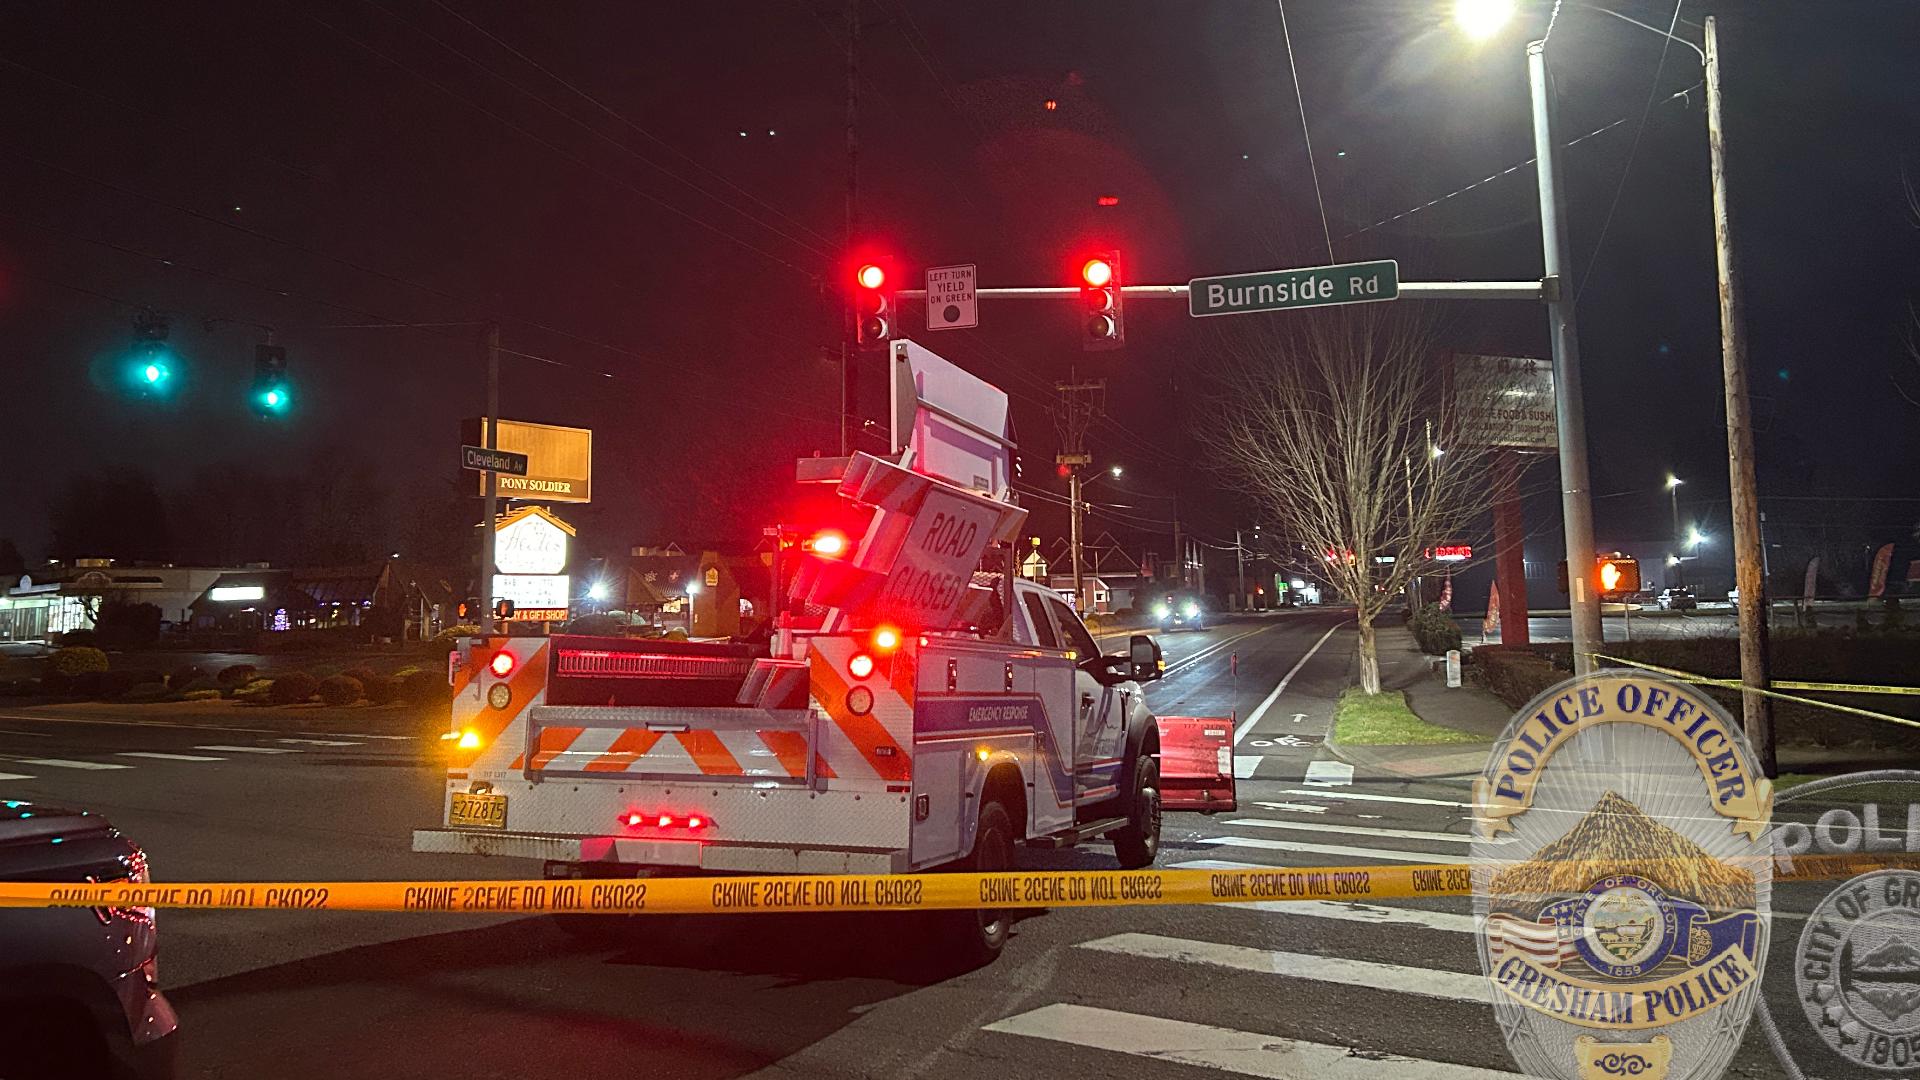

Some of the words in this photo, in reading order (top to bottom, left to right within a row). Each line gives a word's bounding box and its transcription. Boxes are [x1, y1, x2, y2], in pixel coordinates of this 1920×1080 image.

[930, 272, 947, 281] LEFT
[952, 270, 972, 279] TURN
[937, 281, 965, 293] YIELD
[1207, 277, 1334, 308] Burnside
[1350, 275, 1378, 295] Rd
[930, 296, 941, 304] ON
[945, 293, 972, 303] GREEN
[1528, 410, 1555, 422] SUSHI
[467, 450, 510, 470] Cleveland
[513, 462, 523, 472] Av
[501, 478, 530, 490] PONY
[530, 480, 571, 493] SOLDIER
[921, 512, 978, 558] ROAD
[889, 566, 961, 611] CLOSED
[529, 610, 546, 620] GIFT
[546, 610, 565, 620] SHOP
[968, 707, 1001, 722] EMERGENCY
[1002, 705, 1028, 720] RESPONSE
[452, 801, 504, 820] E272875
